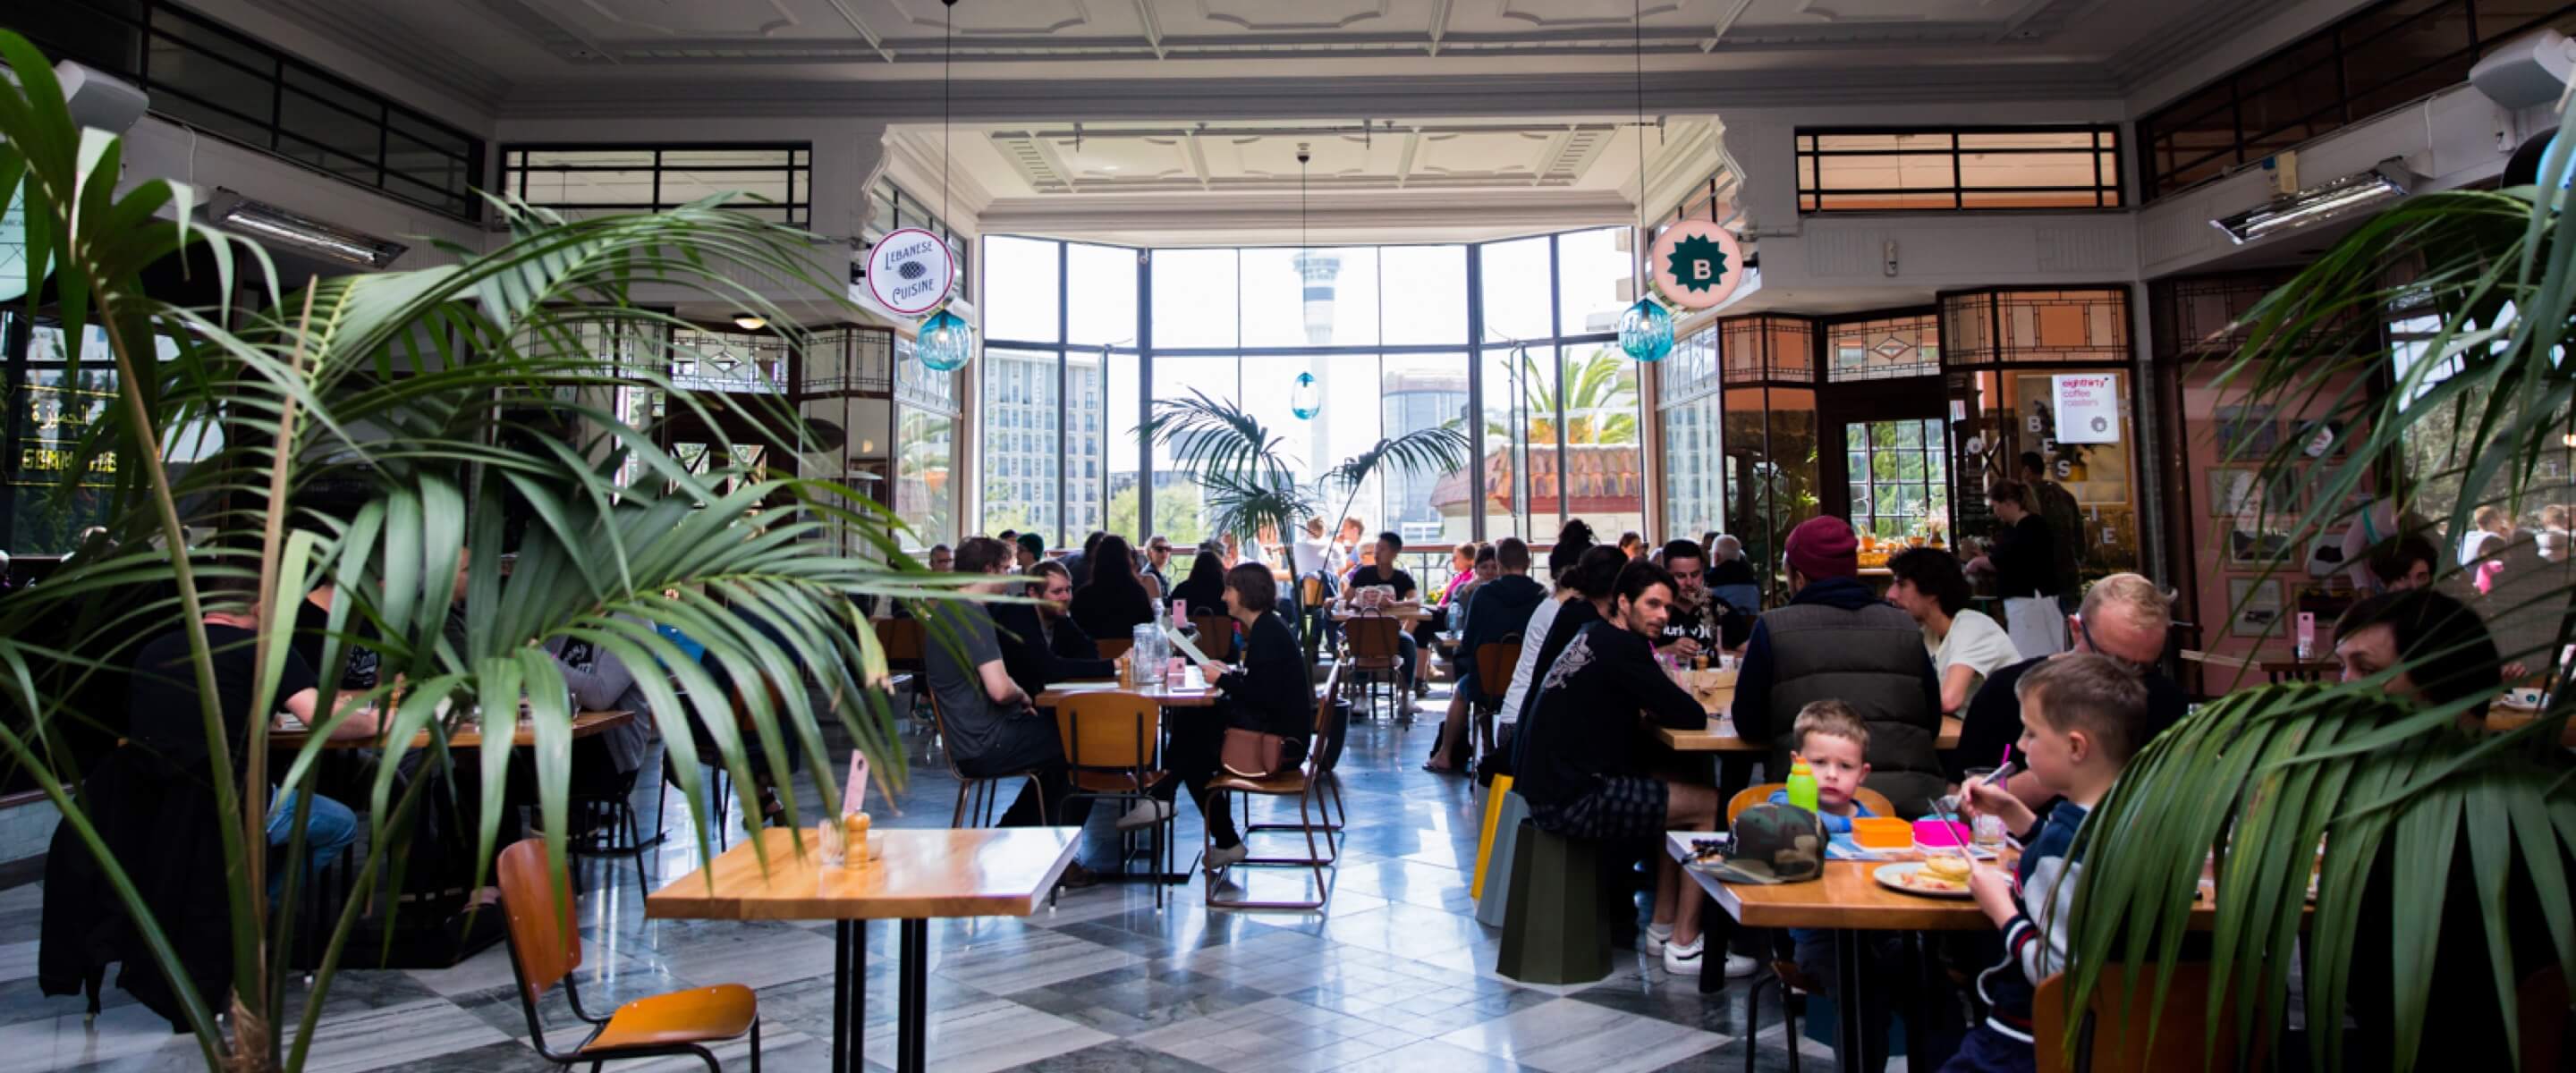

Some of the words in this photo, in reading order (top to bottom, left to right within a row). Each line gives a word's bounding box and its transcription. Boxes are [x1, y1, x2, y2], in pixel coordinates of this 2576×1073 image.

[886, 241, 933, 270] LEBANESE
[1692, 258, 1712, 281] B
[893, 278, 935, 305] CUISINE
[2062, 389, 2091, 398] coffee
